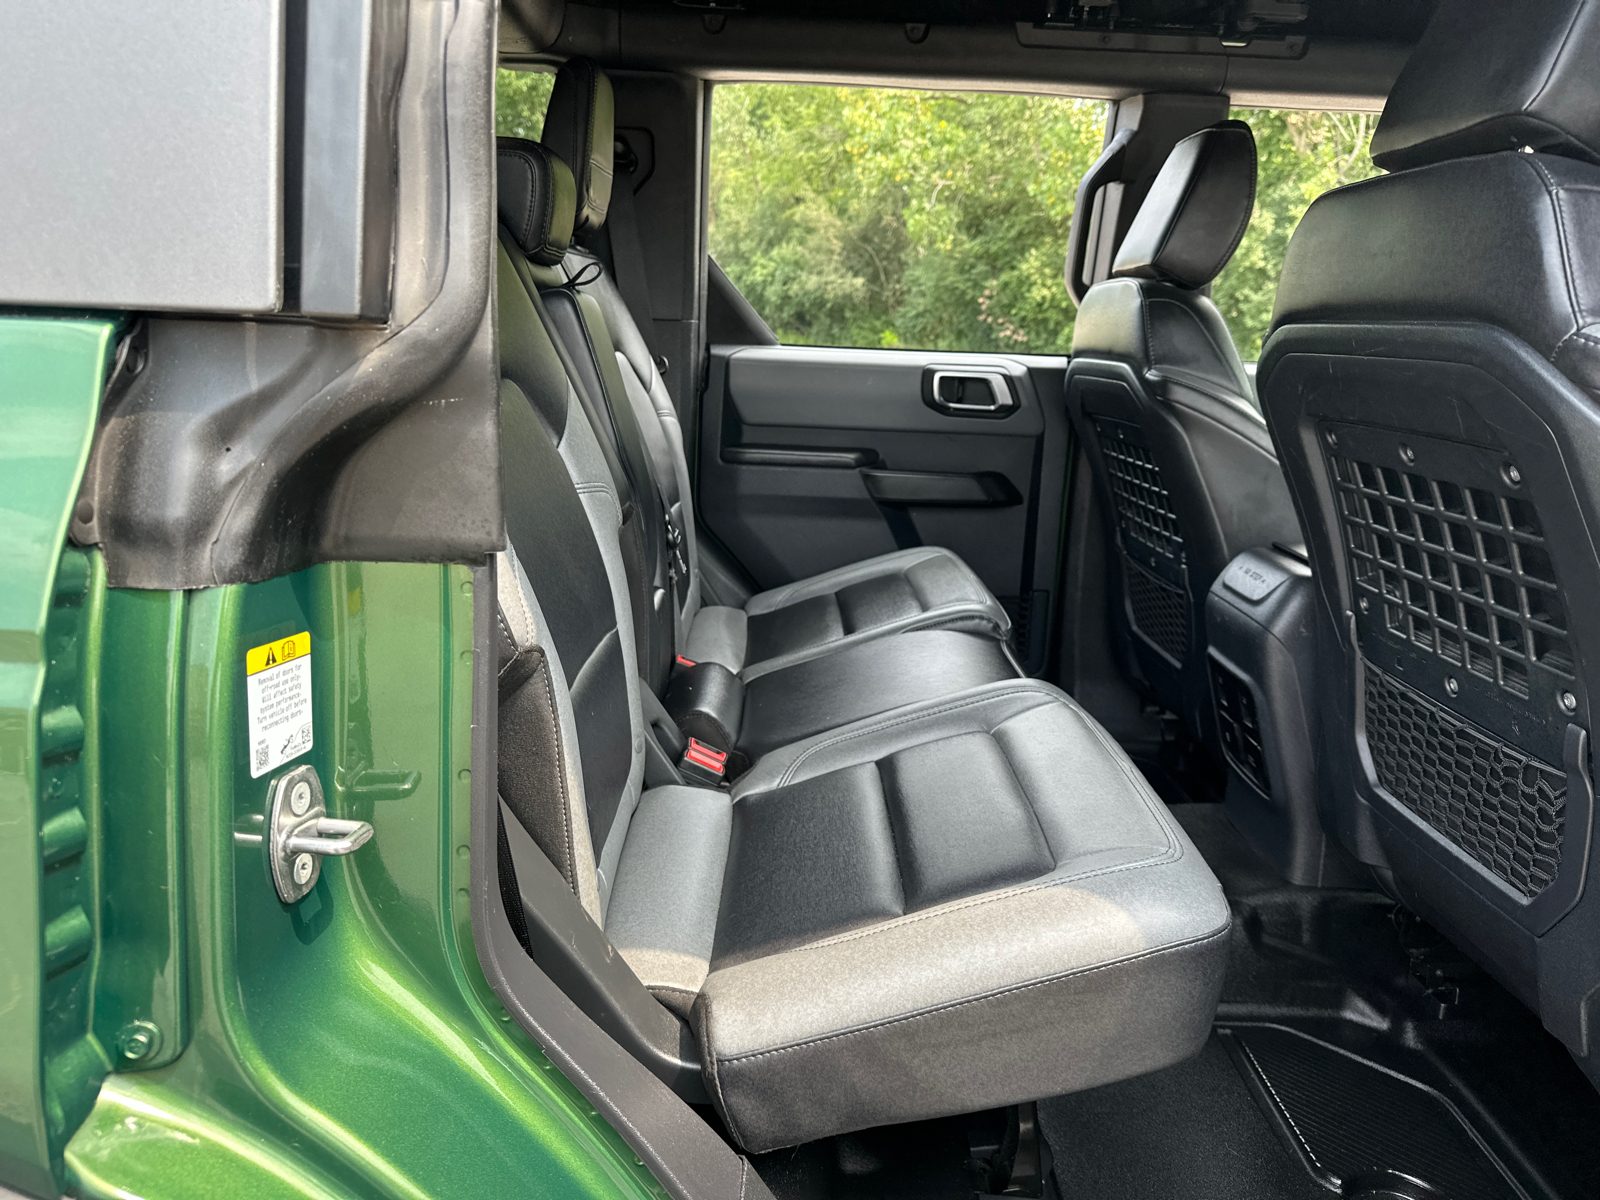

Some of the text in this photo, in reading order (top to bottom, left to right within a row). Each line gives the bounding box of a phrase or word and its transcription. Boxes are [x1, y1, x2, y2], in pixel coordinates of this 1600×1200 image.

[258, 673, 275, 686] Removal
[276, 670, 281, 679] of
[282, 667, 294, 677] doors
[262, 680, 281, 694] off-road
[262, 682, 302, 704] Will affect safety
[257, 715, 268, 725] Turn
[269, 707, 285, 719] vehicle
[294, 697, 307, 709] before
[260, 702, 274, 715] system
[262, 715, 289, 732] reconnecting
